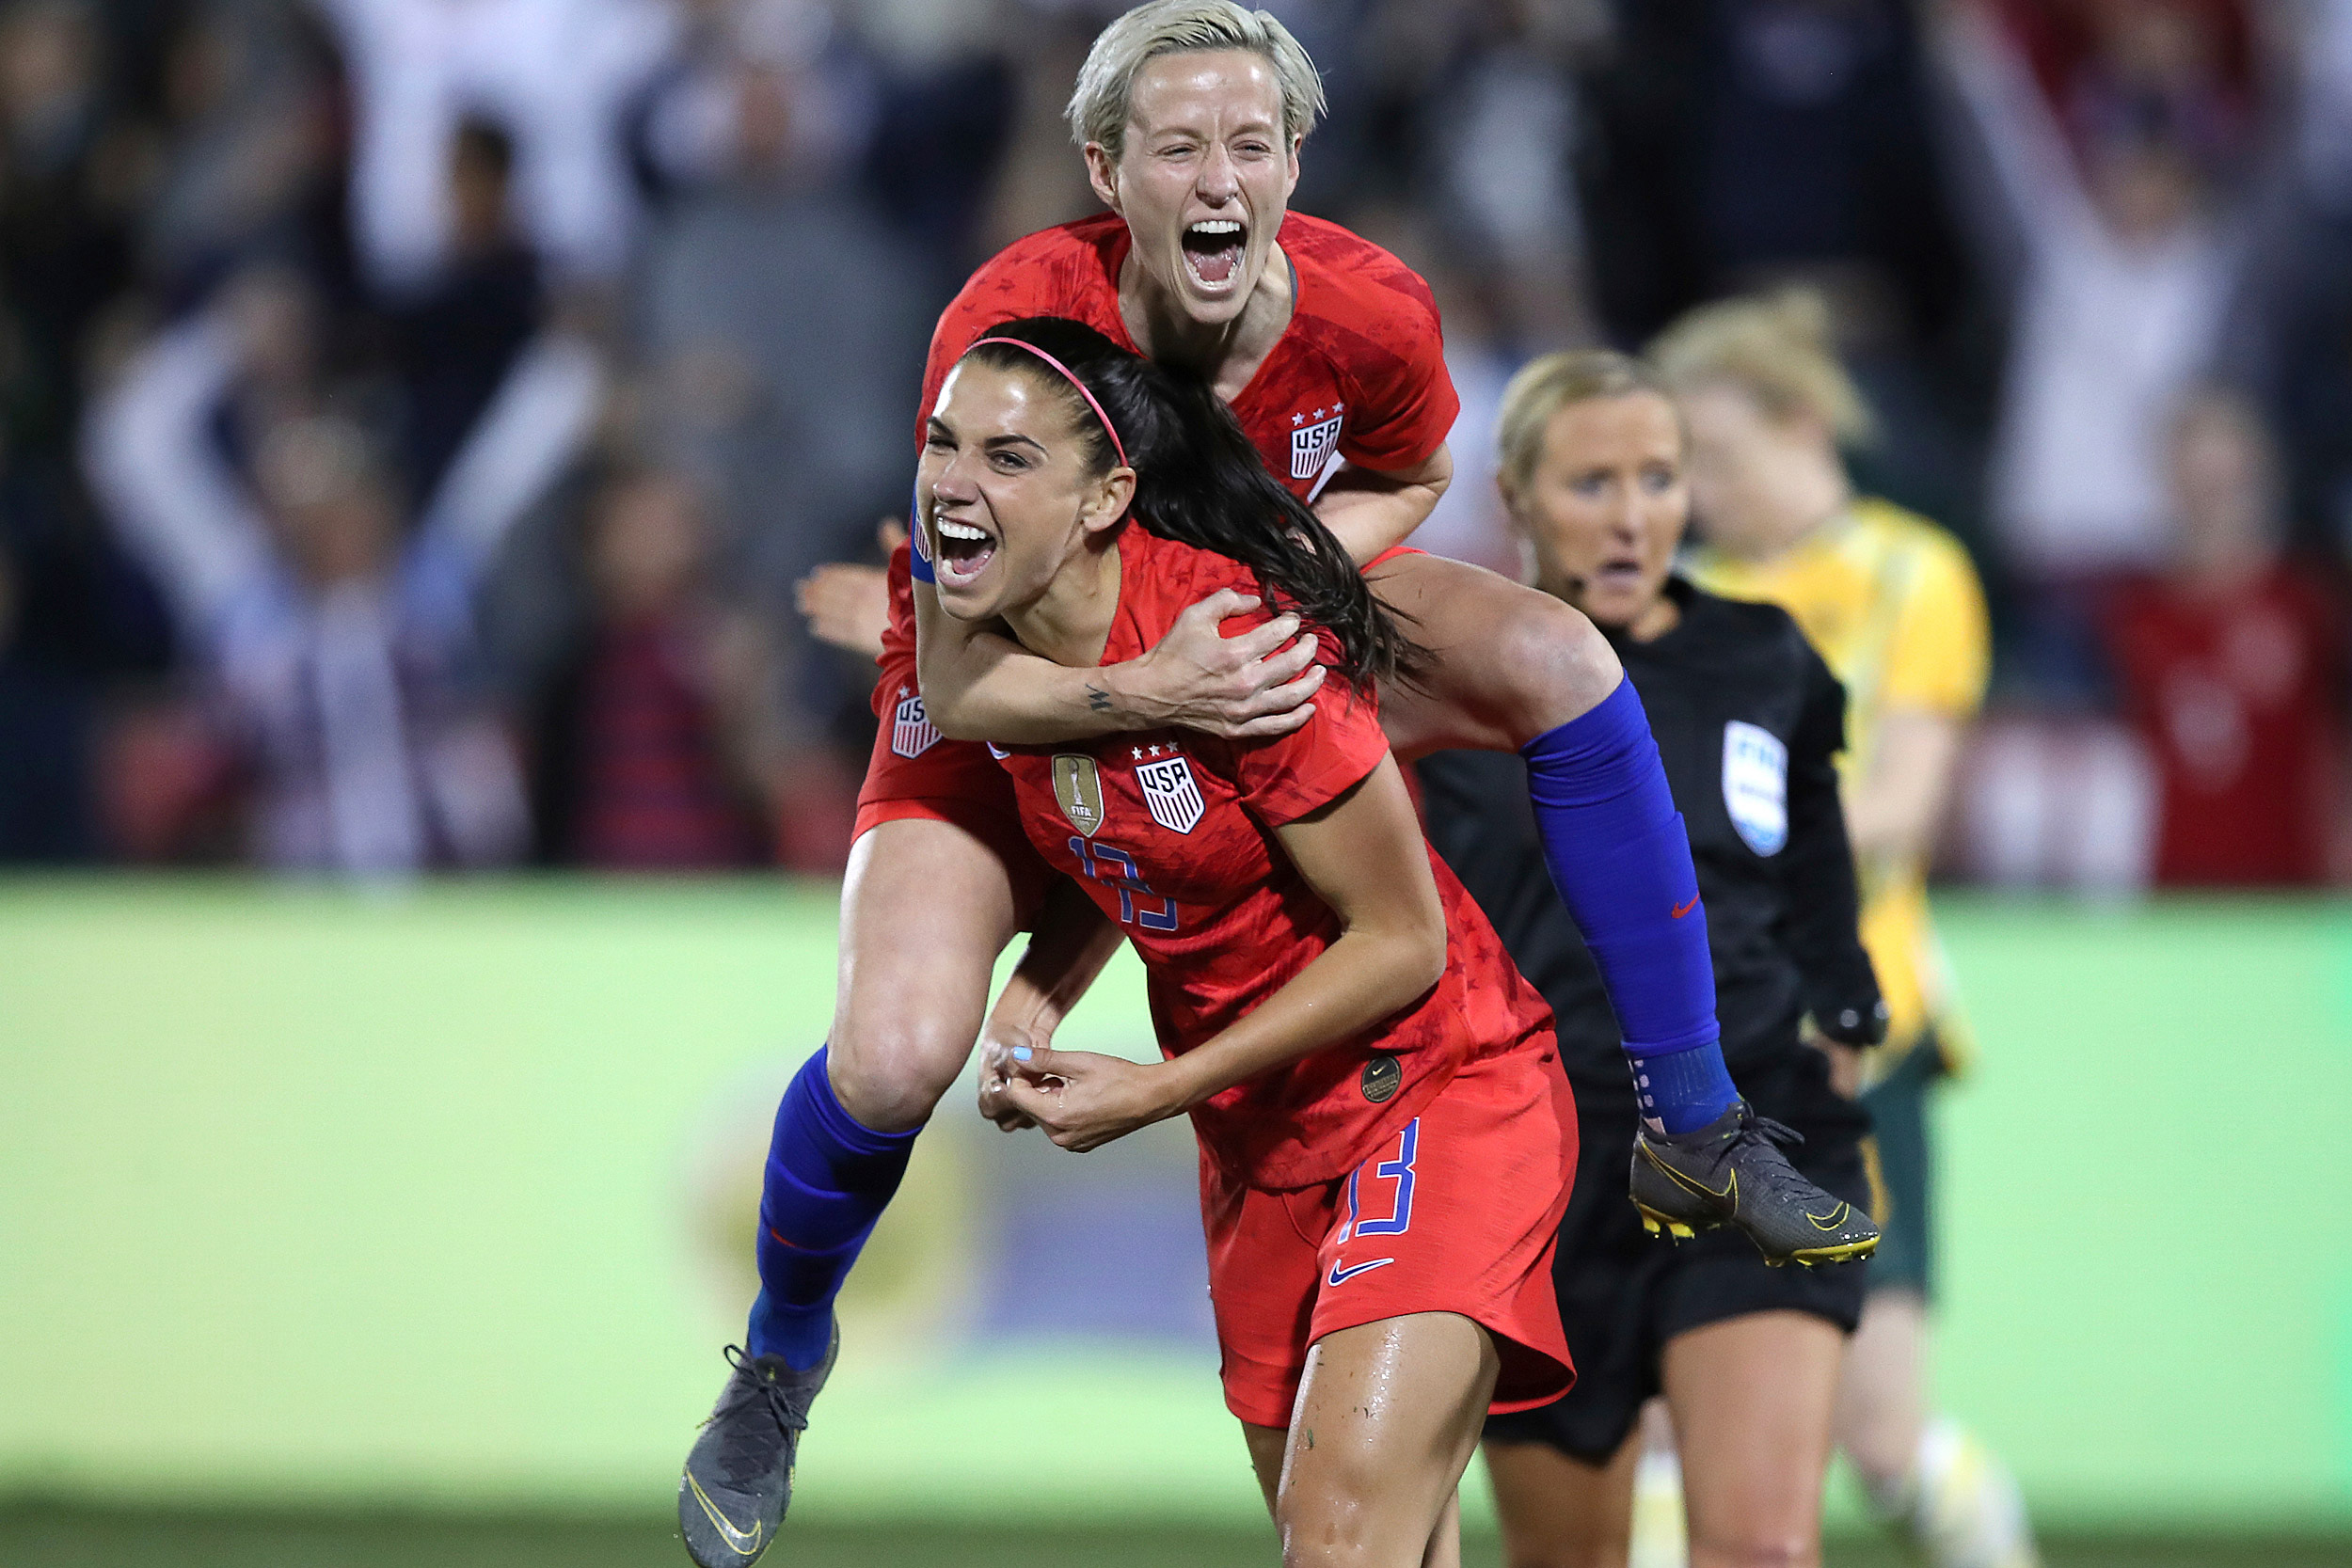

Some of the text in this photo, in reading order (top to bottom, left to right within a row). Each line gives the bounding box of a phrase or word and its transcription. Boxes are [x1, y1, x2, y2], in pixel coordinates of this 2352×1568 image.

[1296, 420, 1339, 449] USA
[899, 700, 925, 722] US
[1141, 762, 1187, 793] USA
[1071, 805, 1092, 817] FIFA
[1068, 836, 1178, 931] 13
[1337, 1117, 1420, 1244] 13
